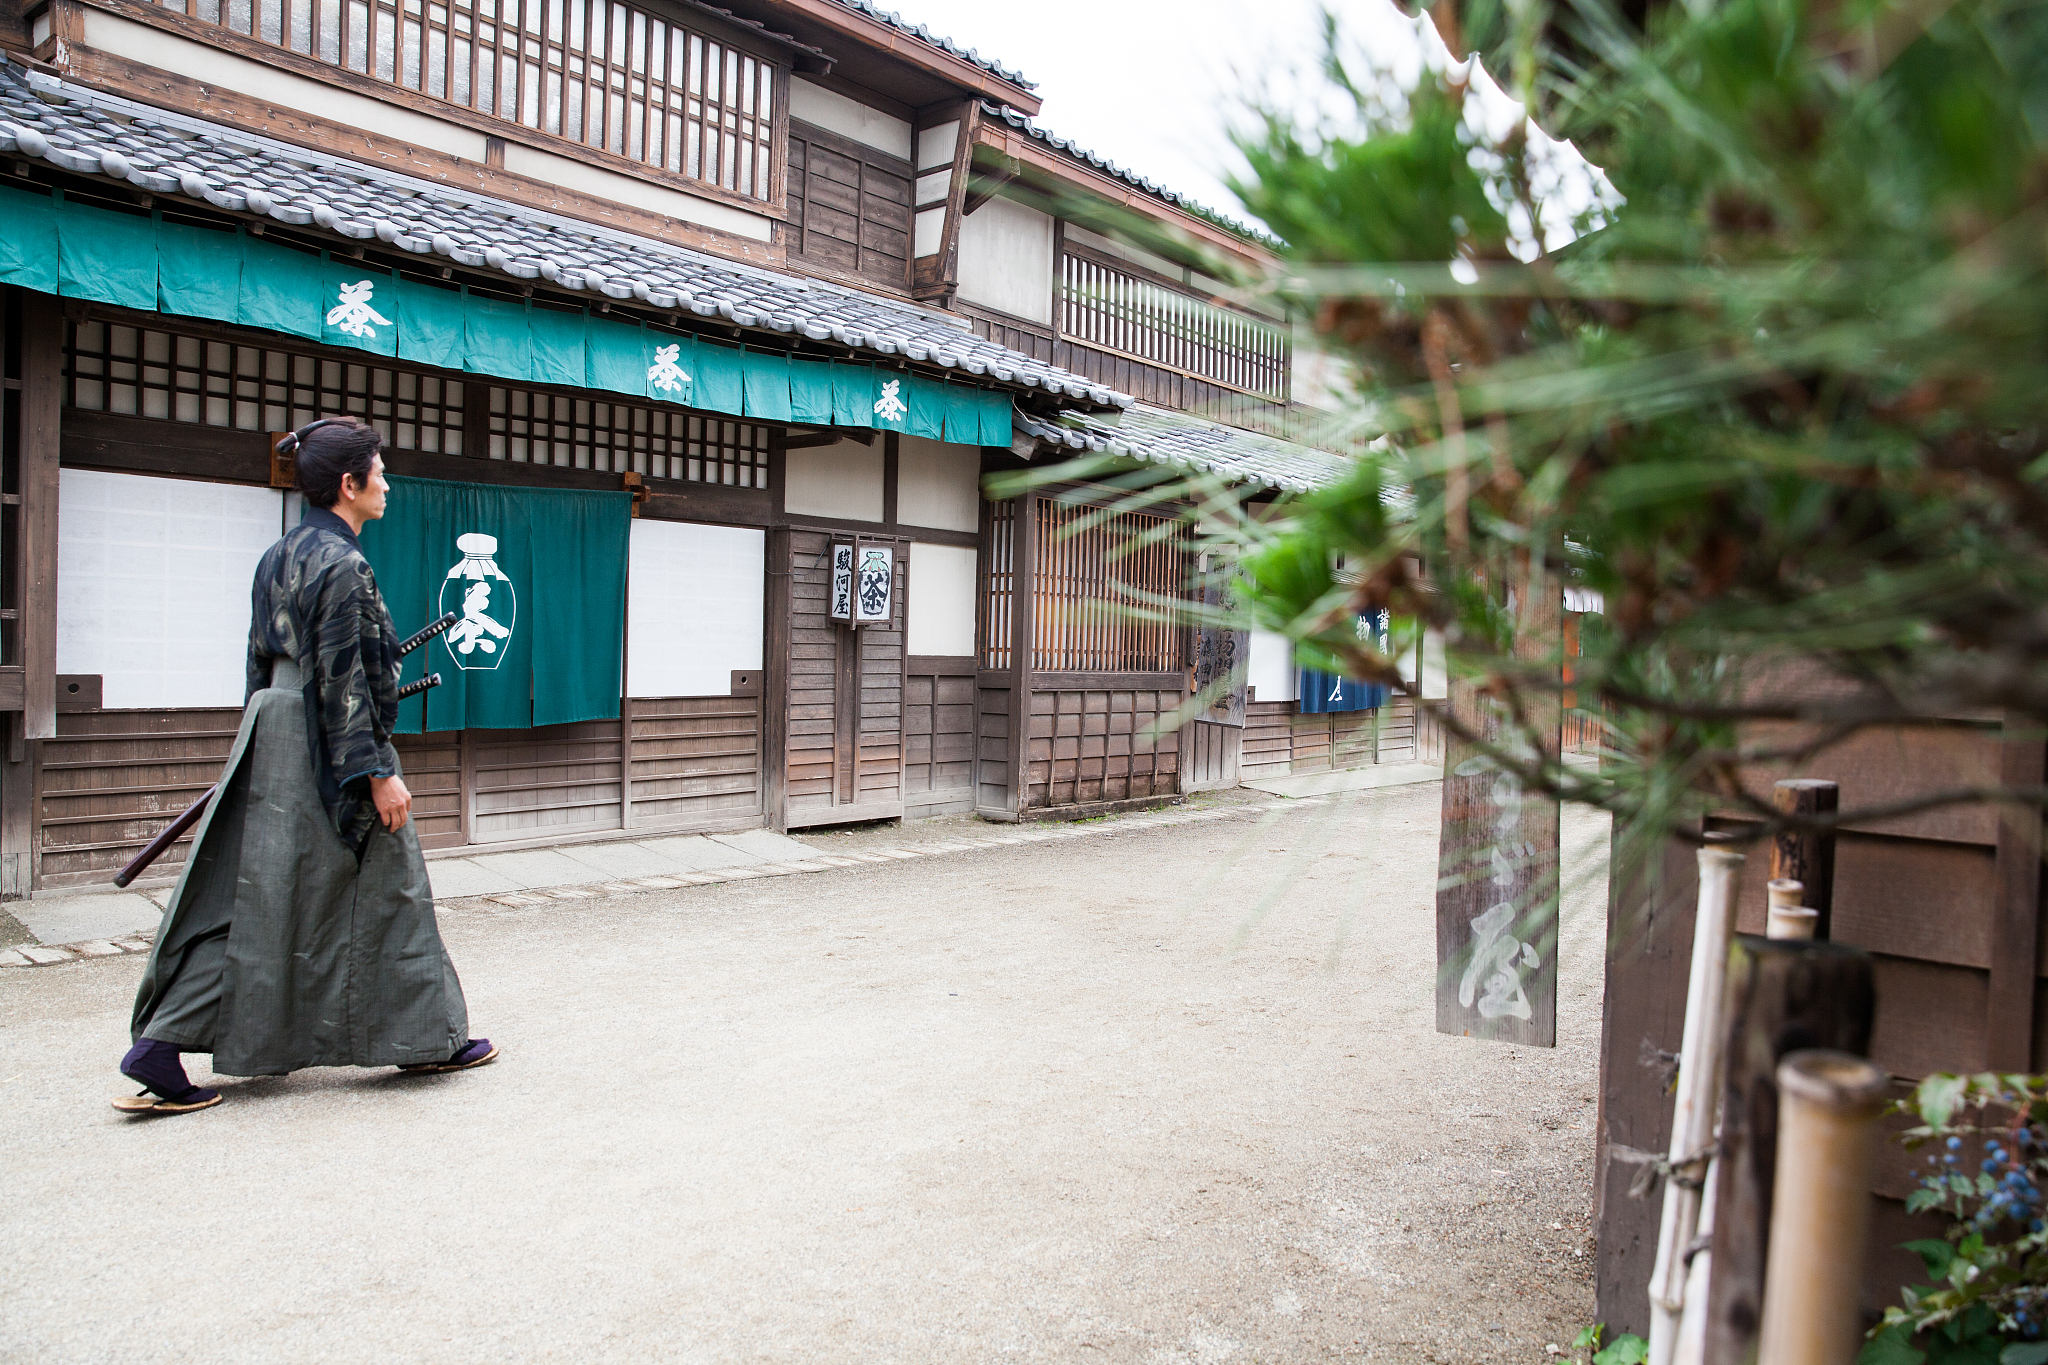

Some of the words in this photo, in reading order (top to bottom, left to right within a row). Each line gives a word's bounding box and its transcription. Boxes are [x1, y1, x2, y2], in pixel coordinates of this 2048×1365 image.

[327, 279, 393, 338] 茶
[648, 343, 692, 392] 茶
[874, 379, 908, 422] 茶
[833, 548, 852, 615] 駿河屋
[862, 572, 887, 611] 茶
[447, 581, 510, 655] 茶
